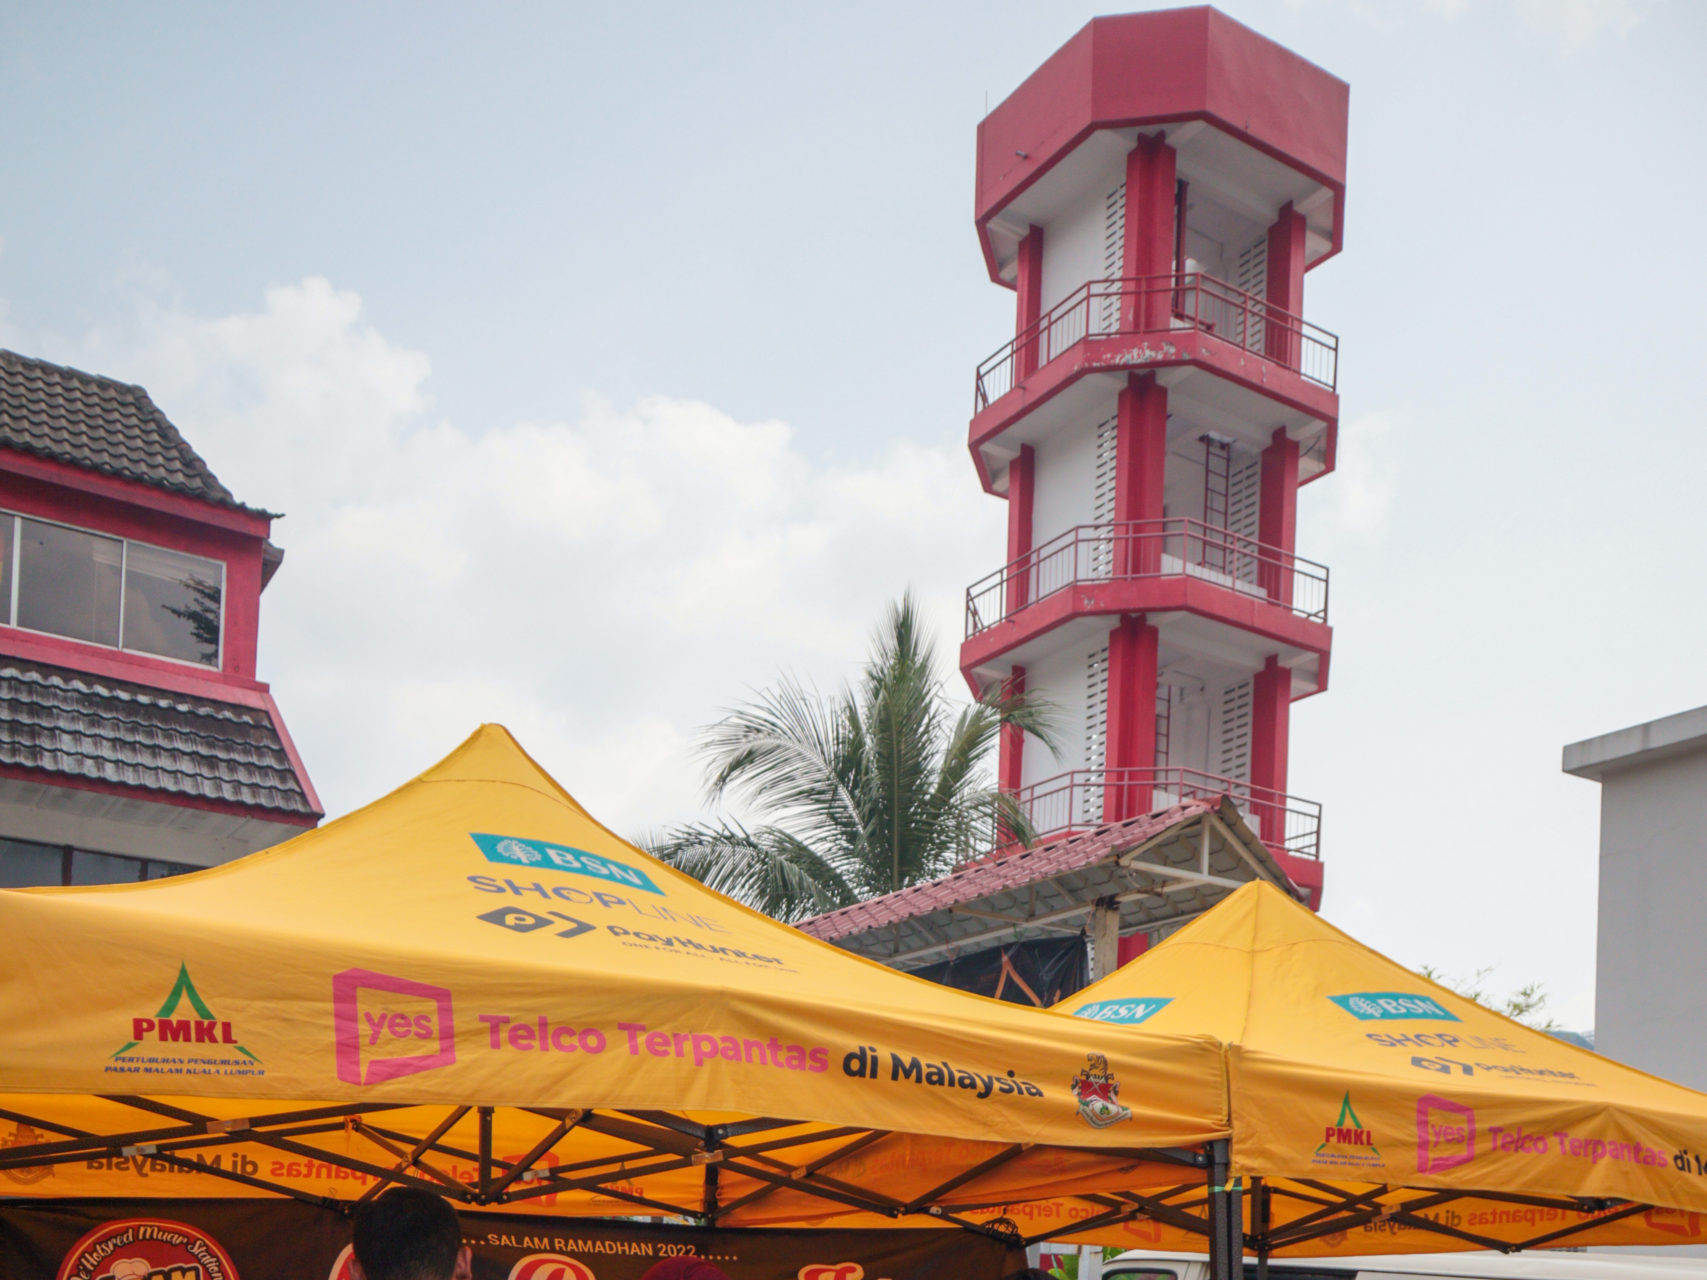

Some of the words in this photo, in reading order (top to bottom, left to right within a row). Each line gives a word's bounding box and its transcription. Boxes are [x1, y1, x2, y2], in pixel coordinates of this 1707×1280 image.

[545, 847, 643, 886] BSN
[467, 875, 733, 934] SHOPLINE
[1094, 1003, 1156, 1019] BSN
[1377, 998, 1445, 1016] BSN
[132, 1017, 238, 1044] PMKL
[363, 1010, 434, 1046] yes
[478, 1014, 607, 1054] Telco
[617, 1022, 830, 1073] Terpantas
[842, 1045, 879, 1079] di
[890, 1052, 1045, 1099] Malaysia
[143, 1066, 183, 1074] MALAM
[185, 1067, 220, 1075] KUALA
[223, 1068, 265, 1076] LUMPUR
[1325, 1126, 1374, 1146] PMKL
[1431, 1123, 1465, 1148] yes
[1488, 1126, 1548, 1154] Telco
[1553, 1131, 1668, 1168] Terpantas
[1673, 1149, 1692, 1174] di
[138, 1225, 188, 1245] Muar
[554, 1238, 653, 1256] RAMADHAN
